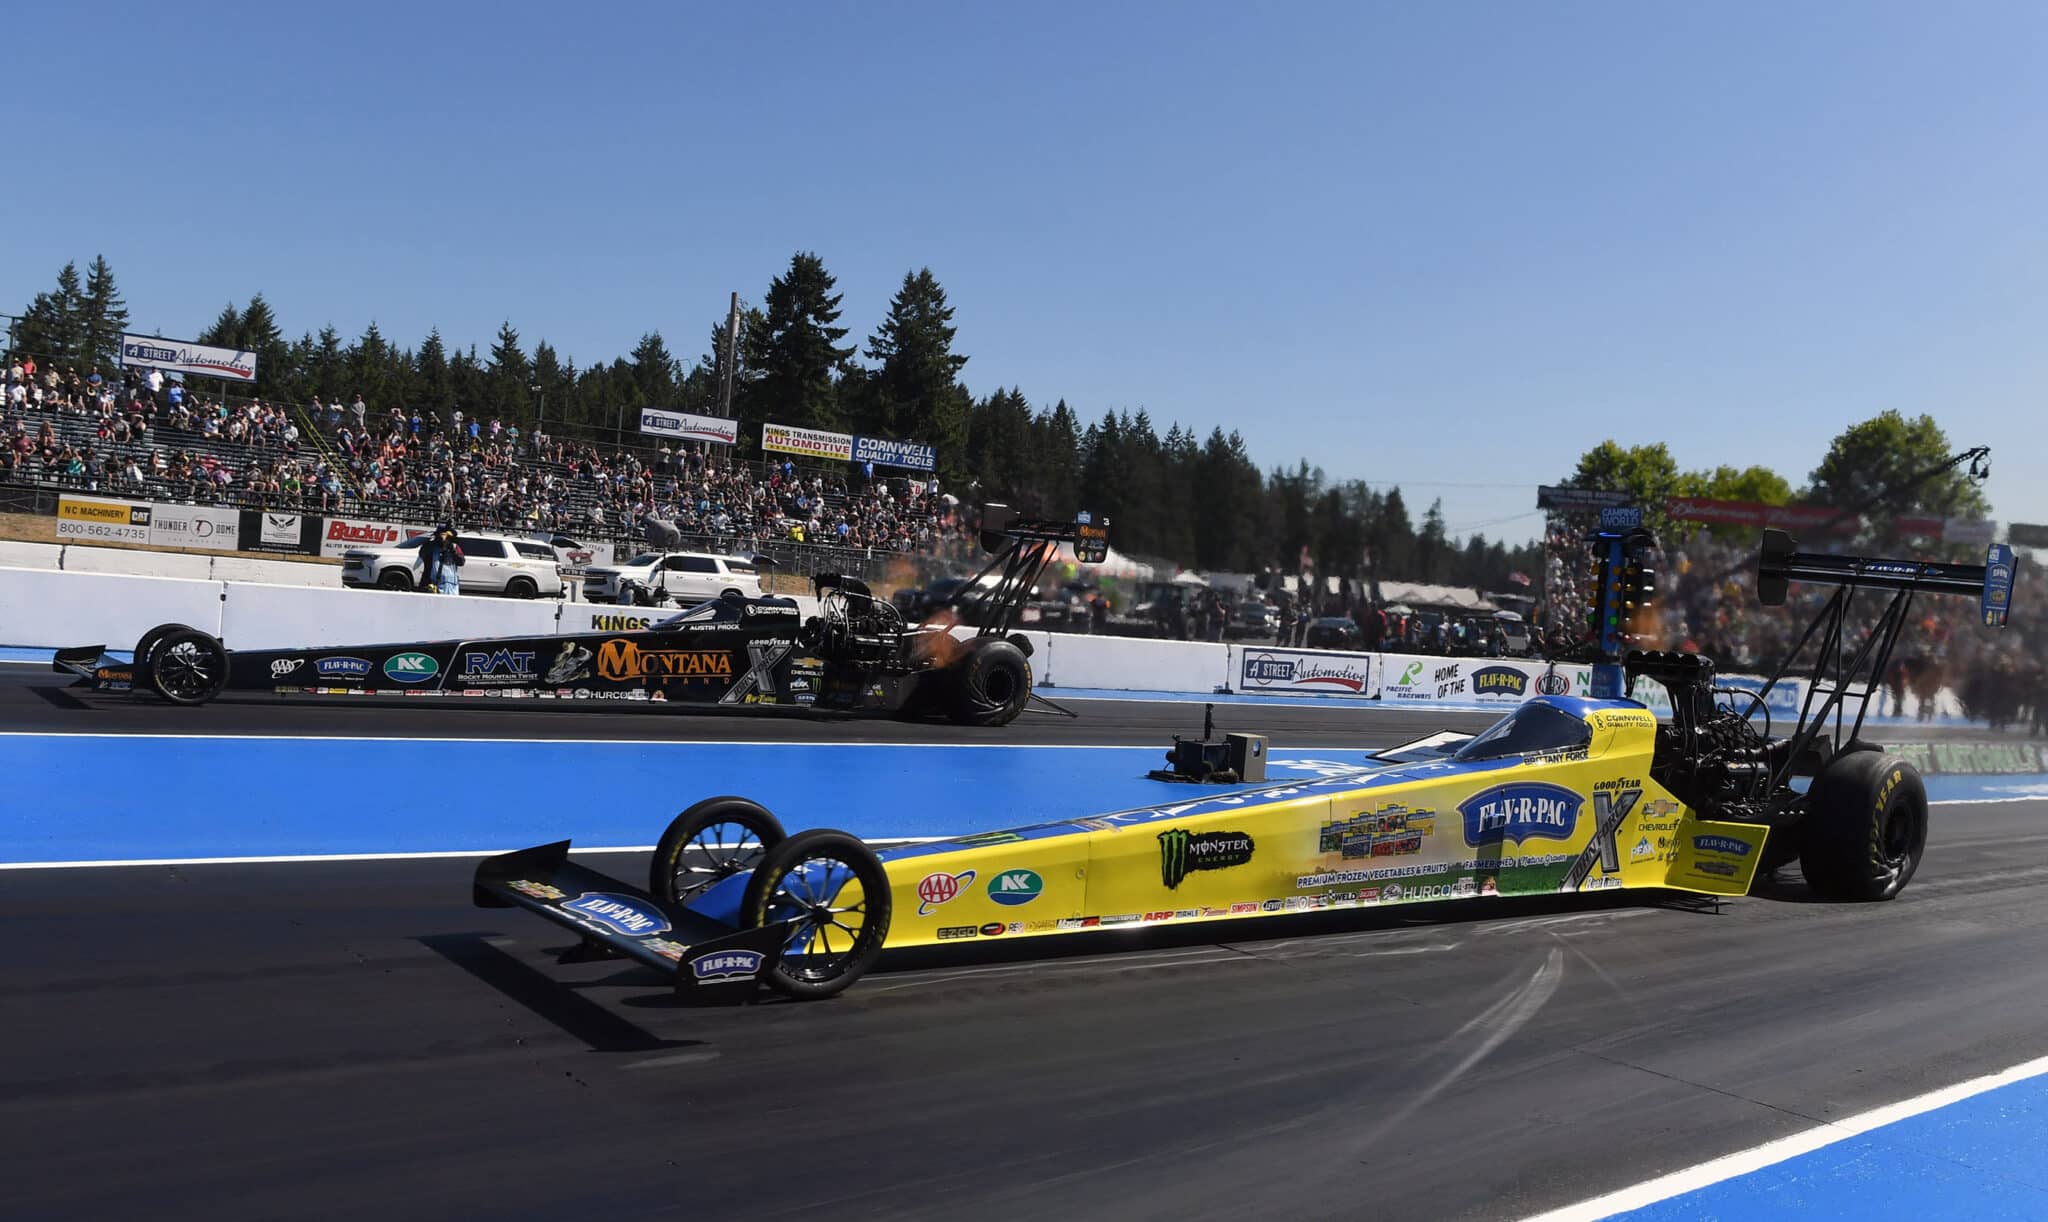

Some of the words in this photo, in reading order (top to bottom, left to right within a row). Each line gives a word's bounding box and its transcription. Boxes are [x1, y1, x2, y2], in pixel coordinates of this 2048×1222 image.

[143, 348, 173, 361] STREET
[176, 348, 254, 372] Automotive
[680, 418, 735, 436] Automotive
[765, 427, 790, 437] KINGS
[793, 431, 851, 445] TRANSMISSION
[766, 435, 850, 454] AUTOMOTIVE
[858, 438, 934, 459] CORNWELL
[856, 449, 899, 462] QUALITY
[902, 455, 934, 467] TOOLS
[80, 507, 124, 519] MACHINERY
[131, 511, 149, 521] CAT
[1601, 508, 1639, 517] CAMPING
[154, 519, 188, 531] THUNDER
[216, 525, 236, 535] DOME
[1103, 518, 1110, 526] 3
[1602, 517, 1639, 526] WORLD
[59, 523, 145, 539] 800-562-4735
[327, 520, 398, 544] Bucky's
[592, 614, 650, 630] KINGS
[398, 657, 425, 670] NK
[465, 648, 536, 674] RMT
[598, 640, 732, 679] MONTANA
[1263, 663, 1290, 677] STREET
[1292, 658, 1365, 679] Automotive
[1435, 663, 1459, 682] HOME
[590, 691, 629, 699] HURCO
[1397, 692, 1431, 700] RACEWAYS
[1437, 683, 1449, 699] OF
[1450, 679, 1465, 696] THE
[1606, 714, 1652, 723] CORNWELL
[1524, 752, 1564, 766] BRITTANY
[1565, 750, 1589, 760] FORCE
[1594, 778, 1641, 791] GOODYEAR
[1638, 823, 1679, 832] CHEVROLET
[1189, 839, 1249, 855] MONSTER
[1198, 855, 1240, 863] ENERGY
[1000, 874, 1031, 891] NK
[1298, 874, 1336, 888] PREMIUM
[1337, 871, 1368, 882] FROZEN
[1369, 866, 1415, 880] VEGETABLES
[1423, 863, 1447, 873] FRUITS
[919, 874, 958, 902] AAA
[1403, 885, 1450, 899] HURCO
[1335, 892, 1356, 901] WELD
[1143, 911, 1174, 921] ARP
[1176, 910, 1198, 918] MAHLE
[1232, 904, 1258, 913] SIMPSON
